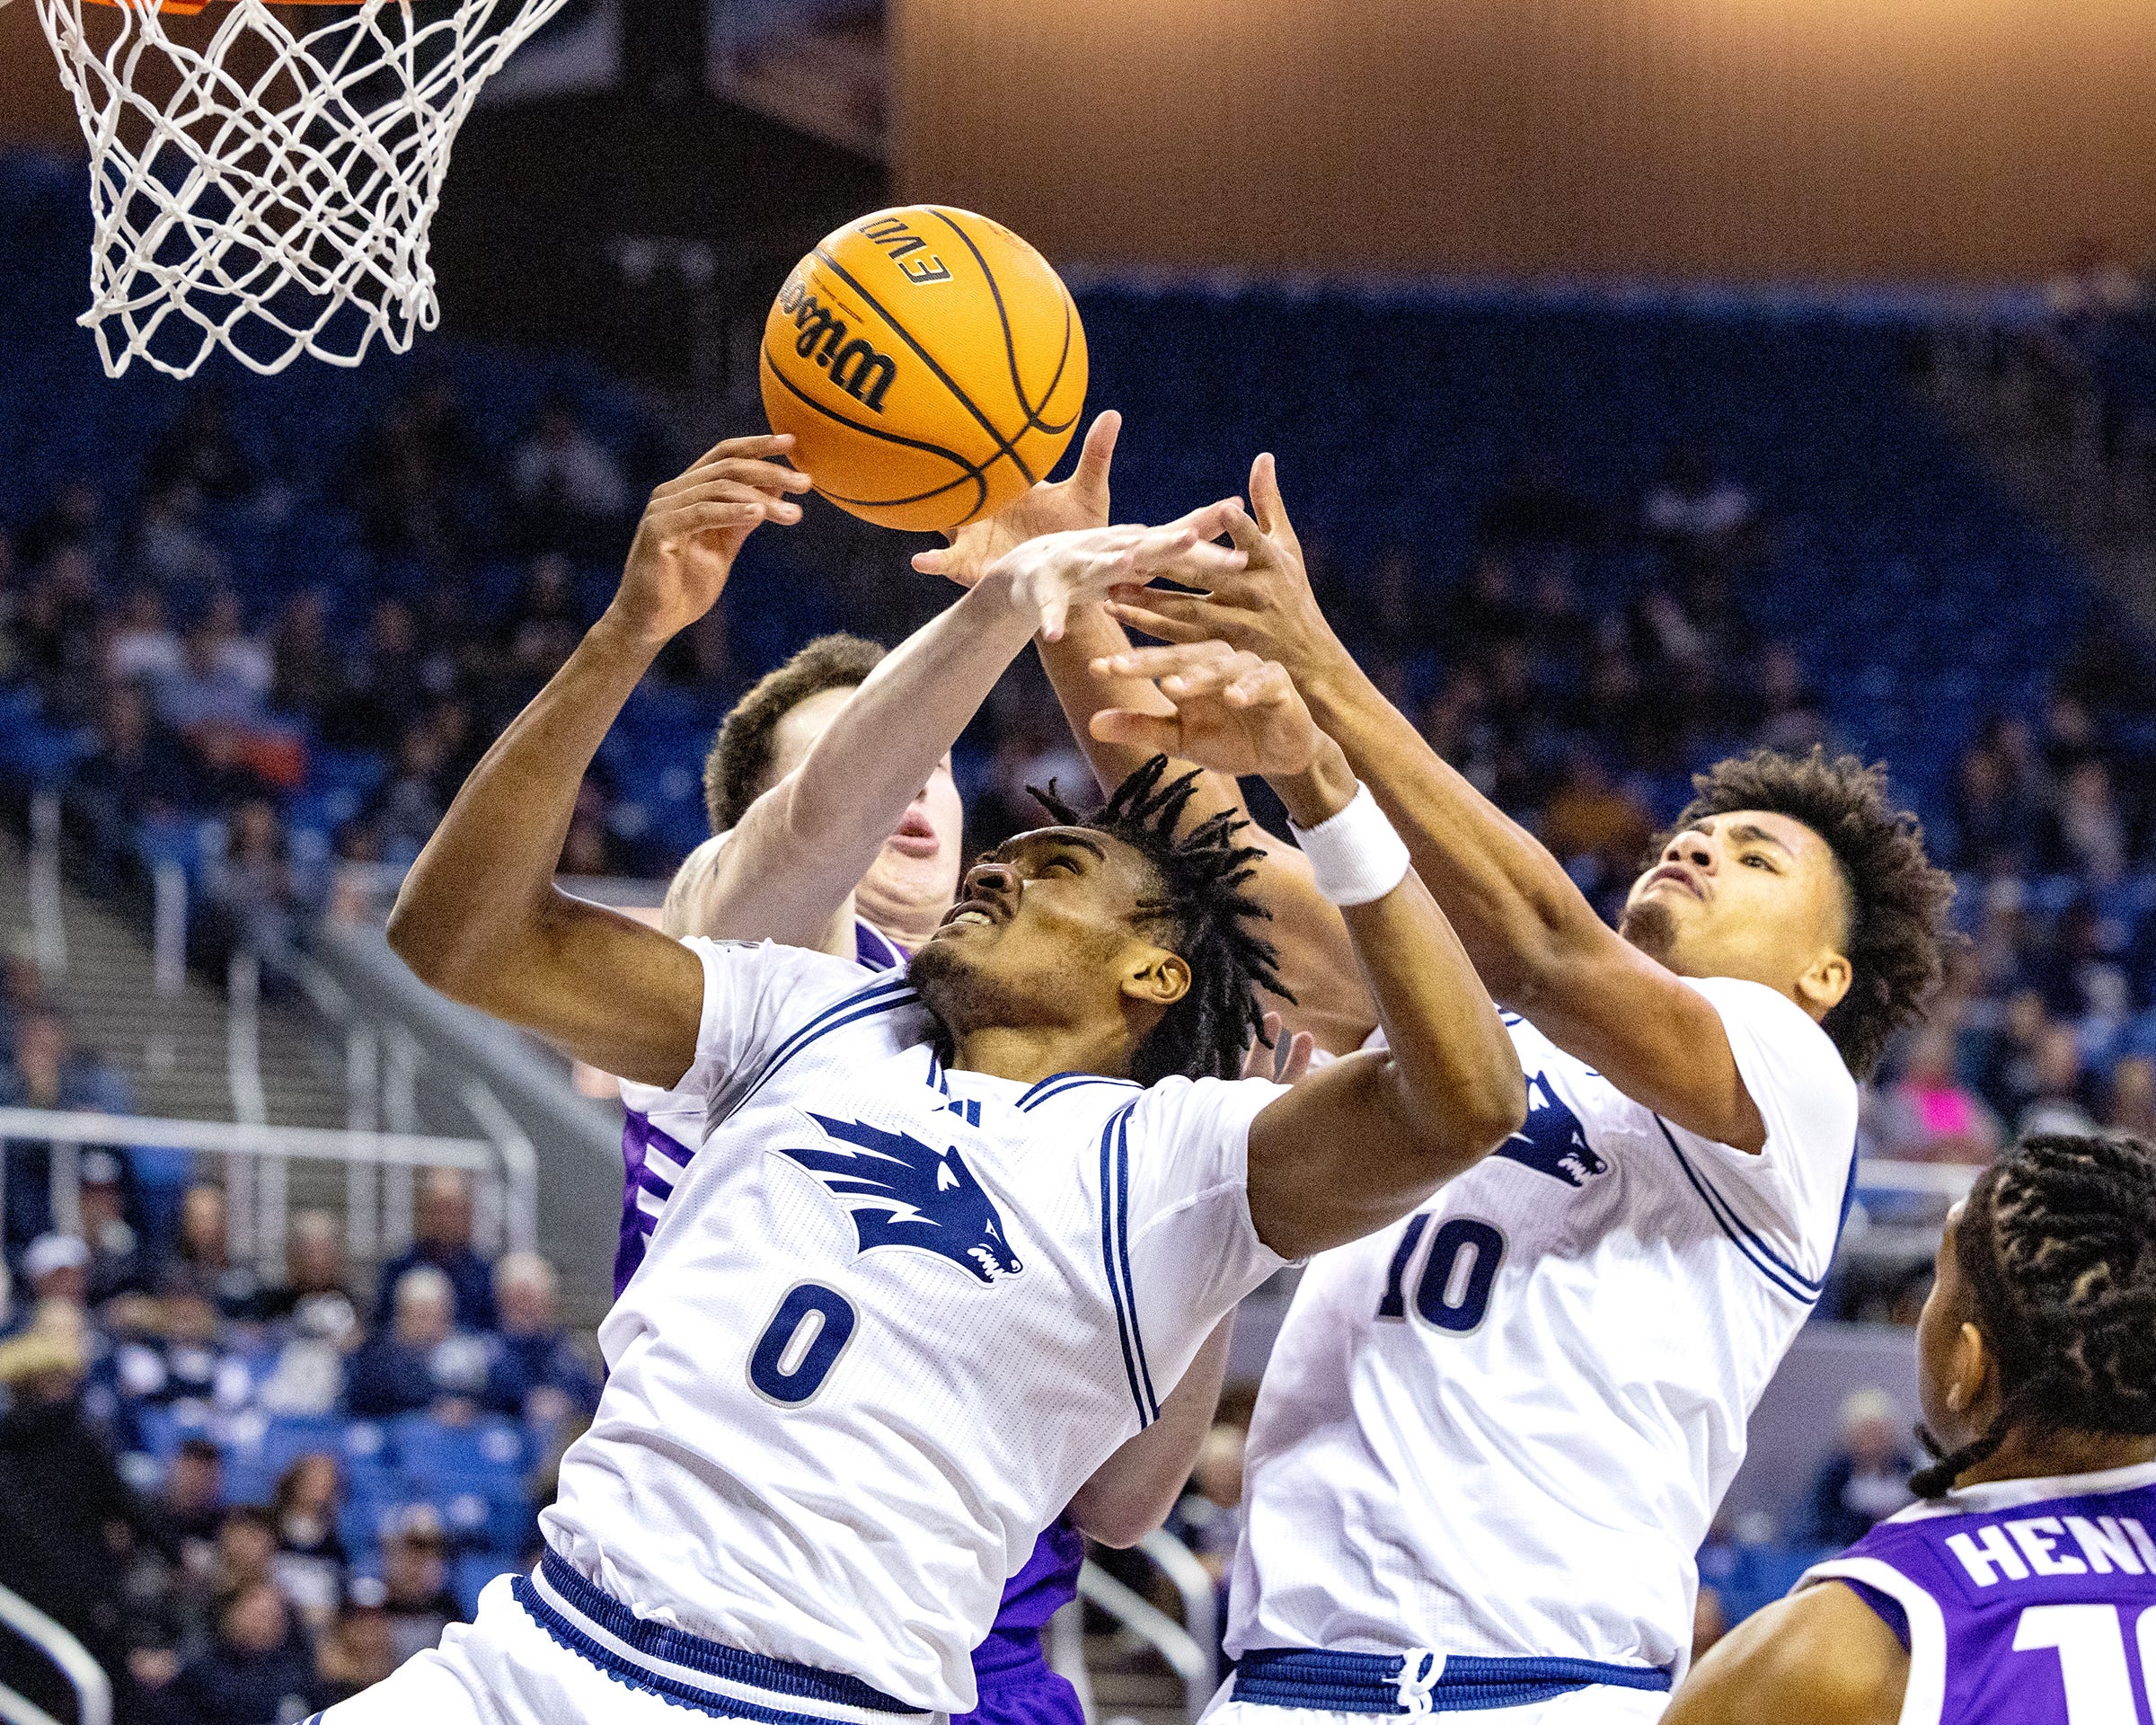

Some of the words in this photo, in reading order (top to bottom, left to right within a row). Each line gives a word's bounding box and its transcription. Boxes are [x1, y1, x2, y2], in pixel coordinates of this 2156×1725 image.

[1374, 1209, 1510, 1338] 10
[745, 1278, 861, 1410] 0
[2012, 1604, 2156, 1725] 1
